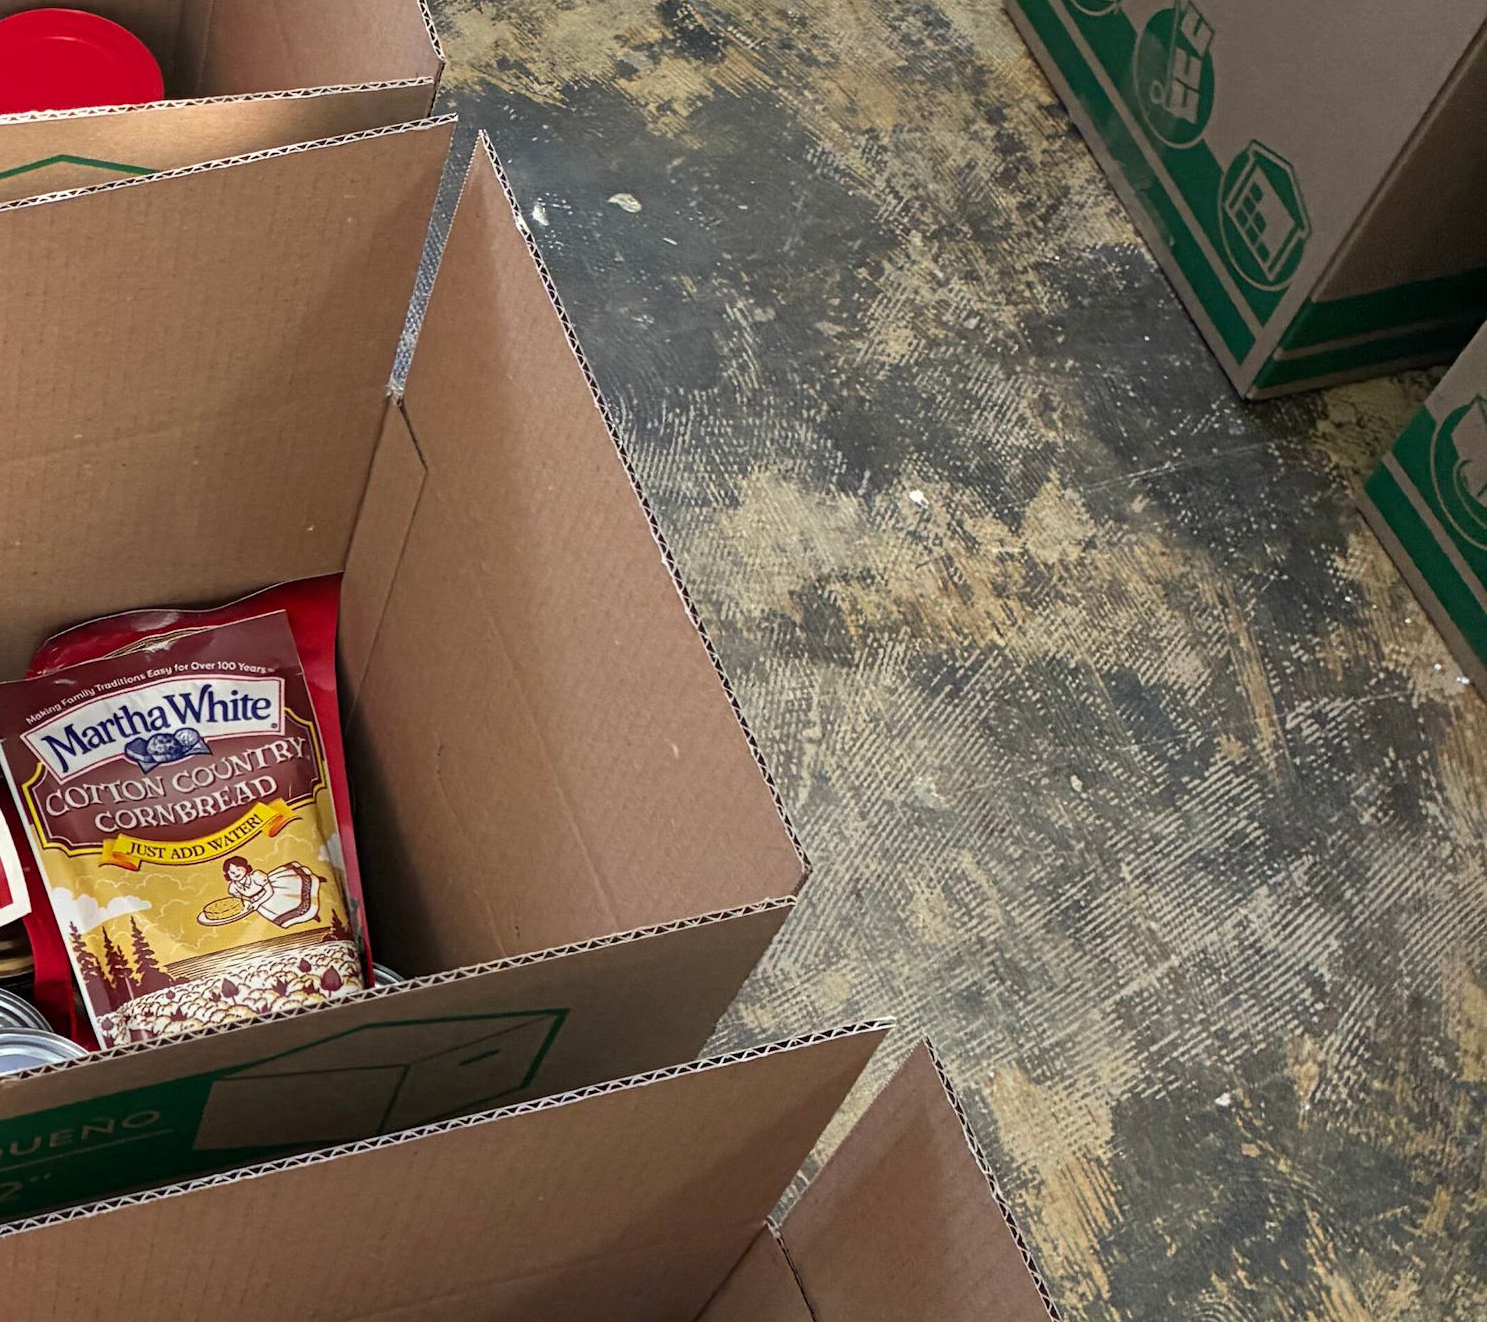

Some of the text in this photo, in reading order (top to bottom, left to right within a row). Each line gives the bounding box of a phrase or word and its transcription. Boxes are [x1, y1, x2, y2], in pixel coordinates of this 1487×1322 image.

[26, 702, 59, 725] Making
[61, 689, 92, 712] Family
[94, 673, 145, 696] Traditions
[147, 666, 171, 681] Easy
[173, 662, 188, 675] for
[190, 661, 215, 672] Over
[217, 660, 236, 670] 100
[42, 684, 271, 773] Martha White
[45, 738, 309, 819] COTTON COUNTRY
[95, 775, 277, 834] CORNBREAD
[126, 818, 262, 859] JUST ADD WATER!
